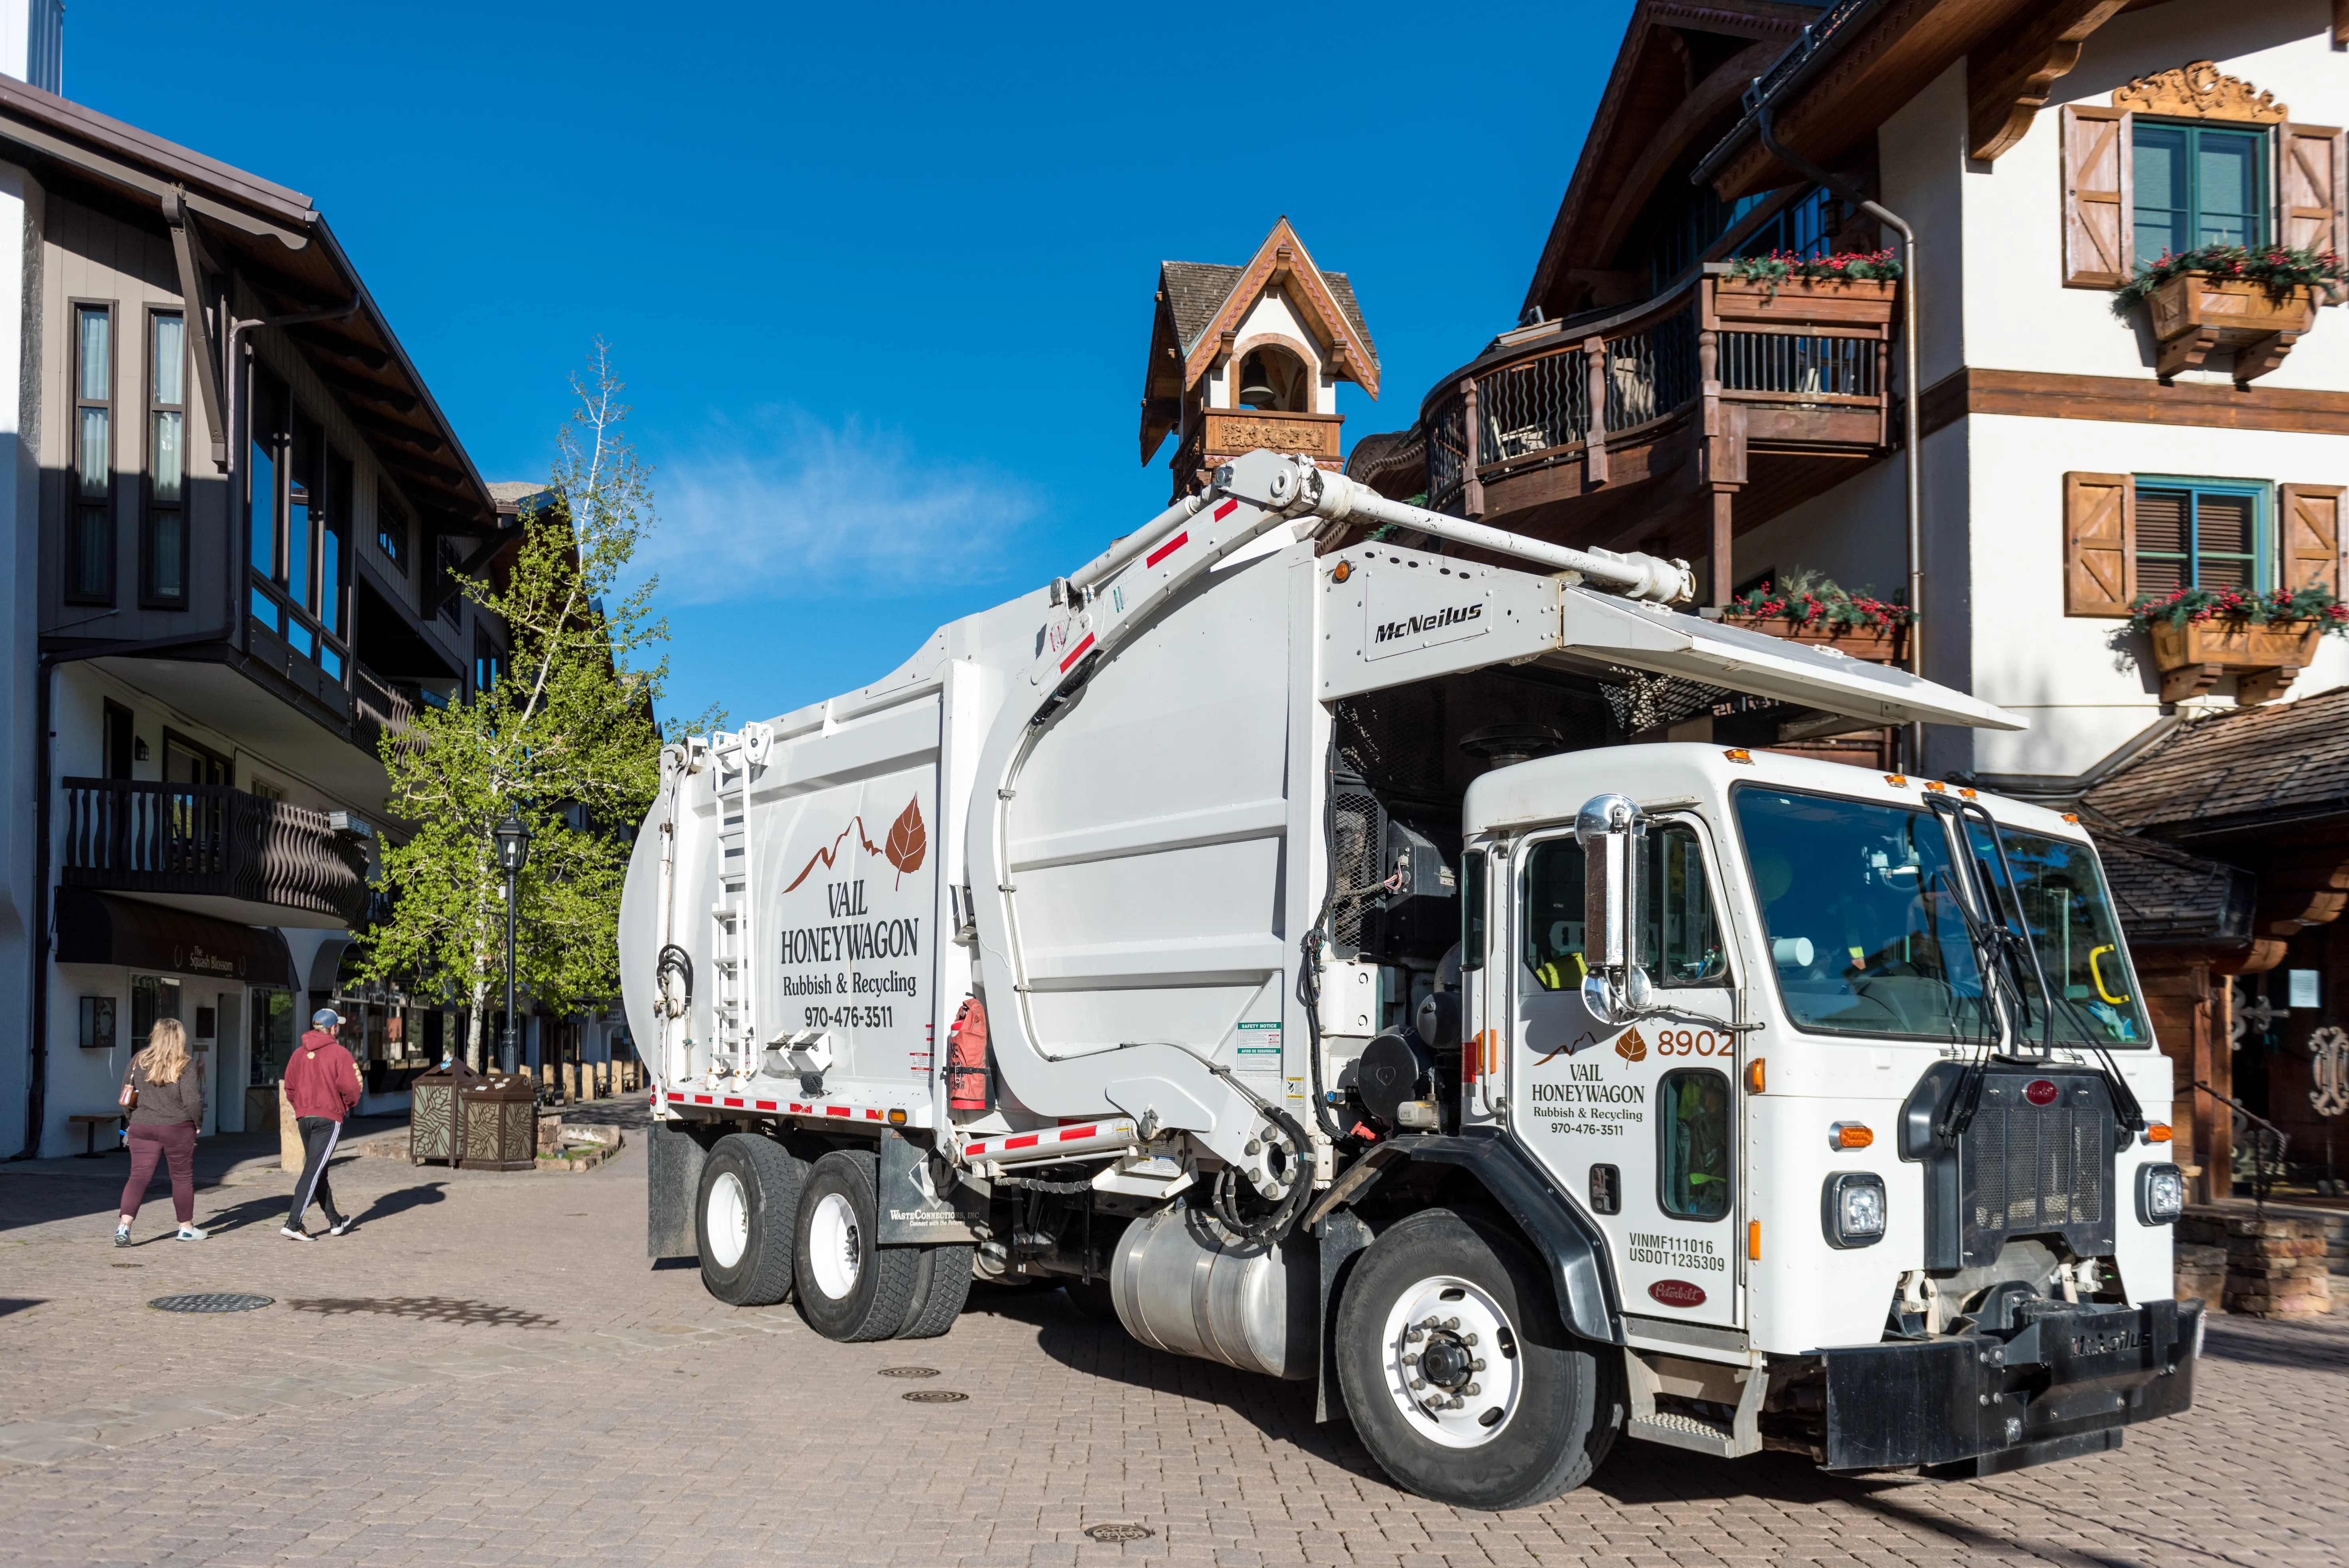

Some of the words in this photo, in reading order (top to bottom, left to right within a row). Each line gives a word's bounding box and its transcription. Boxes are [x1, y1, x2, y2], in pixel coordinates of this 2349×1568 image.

[1374, 603, 1483, 644] McNeilus
[827, 879, 868, 918] VAIL
[194, 946, 203, 957] The
[781, 918, 919, 964] HONEYWAGON
[190, 953, 210, 970] Squash
[211, 955, 233, 972] Blossom
[783, 973, 832, 996] Rubbish
[836, 972, 848, 993] &
[852, 970, 916, 997] Recycling
[805, 1005, 892, 1028] 970-476-3511
[1657, 1030, 1735, 1057] 8902
[1570, 1064, 1603, 1082] VAIL
[1532, 1084, 1645, 1104] HONEYWAGON
[1533, 1106, 1575, 1119] Rubbish
[1578, 1108, 1587, 1118] &
[1590, 1108, 1643, 1122] Recycling
[1551, 1122, 1624, 1136] 970-476-3511
[1629, 1232, 1713, 1254] VINMF111016
[1630, 1248, 1725, 1272] USDOT1235309
[1655, 1283, 1701, 1301] Peterbilt
